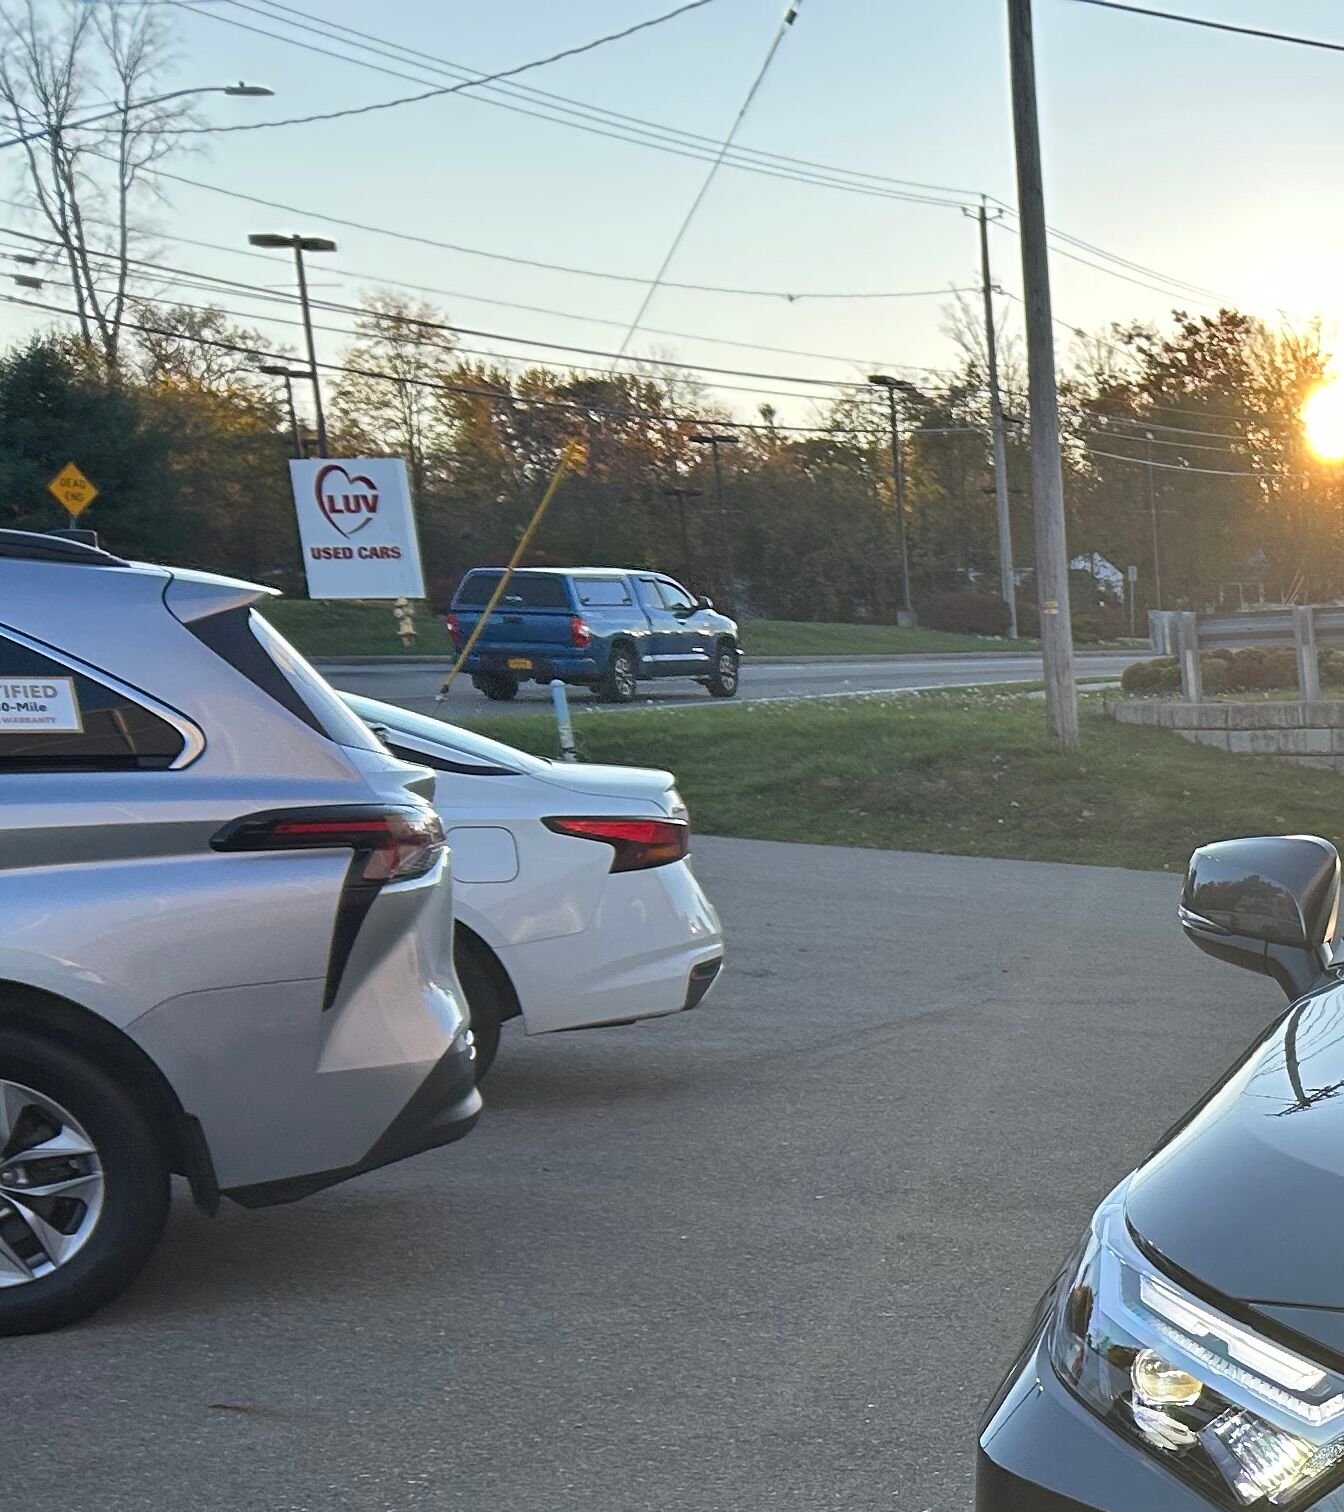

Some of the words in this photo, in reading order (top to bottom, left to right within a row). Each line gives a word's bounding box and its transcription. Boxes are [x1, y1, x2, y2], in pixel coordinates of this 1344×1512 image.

[59, 478, 86, 489] DEAD
[65, 491, 84, 502] END
[327, 494, 379, 514] LUV
[310, 547, 353, 560] USED
[358, 546, 401, 560] CARS
[0, 702, 47, 712] 0-Mile
